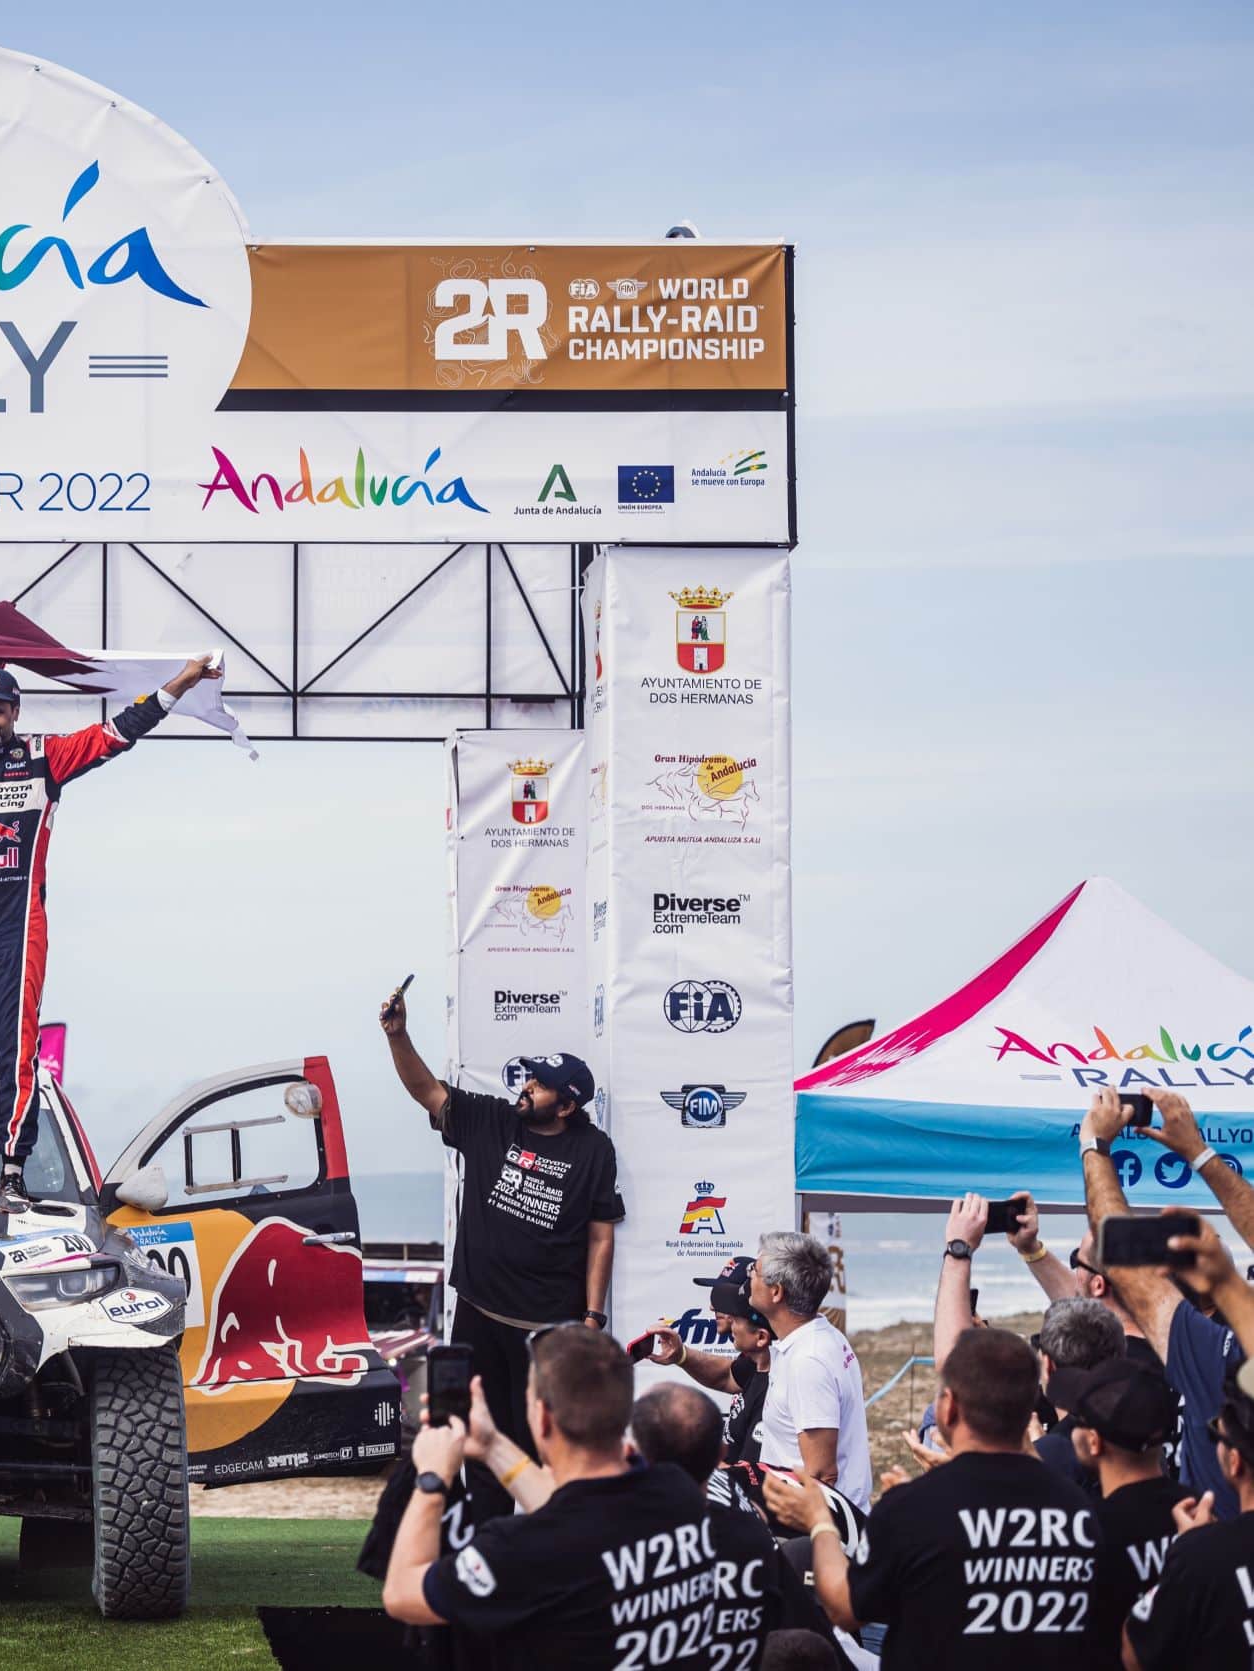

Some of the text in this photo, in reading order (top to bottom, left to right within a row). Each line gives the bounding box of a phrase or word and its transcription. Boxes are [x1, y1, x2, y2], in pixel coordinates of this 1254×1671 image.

[658, 278, 749, 300] WORLD
[435, 279, 548, 361] 2R
[568, 305, 758, 333] RALLY-RAID
[568, 338, 766, 361] CHAMPIONSHIP
[195, 445, 491, 514] Andalucía
[691, 468, 727, 477] Andalucía
[691, 476, 765, 487] se mueve con Europa
[38, 471, 152, 512] 2022
[513, 505, 602, 516] Junta de Andalucía
[641, 678, 762, 690] AYUNTAMIENTO DE
[649, 692, 754, 705] DOS HERMANAS
[654, 754, 727, 765] Gran Hipódromo
[710, 756, 757, 782] Andalucía
[485, 827, 576, 837] AYUNTAMIENTO DE
[645, 835, 675, 843] APUESTA
[704, 836, 742, 844] ANDALUZA
[491, 838, 569, 848] DOS HERMANAS
[653, 893, 741, 912] Diverse
[653, 912, 741, 924] ExtremeTeam
[652, 923, 684, 934] .com
[494, 990, 561, 1004] Diverse
[494, 1004, 561, 1014] ExtremeTeam
[494, 1013, 517, 1022] .com
[987, 1024, 1254, 1066] Andalucí
[689, 1097, 718, 1116] FIM
[494, 1179, 561, 1215] 2022 WINNERS
[523, 1180, 563, 1197] RALLY-RAID
[496, 1202, 554, 1230] MATHIEU BAUMEL
[52, 1234, 92, 1253] 200
[666, 1240, 744, 1249] Real Federación Española
[677, 1249, 685, 1257] de
[109, 1297, 165, 1317] eurol
[214, 1460, 263, 1475] EDGECAM
[959, 1507, 1096, 1549] W2RC
[963, 1556, 1095, 1585] WINNERS
[962, 1590, 1089, 1634] 2022
